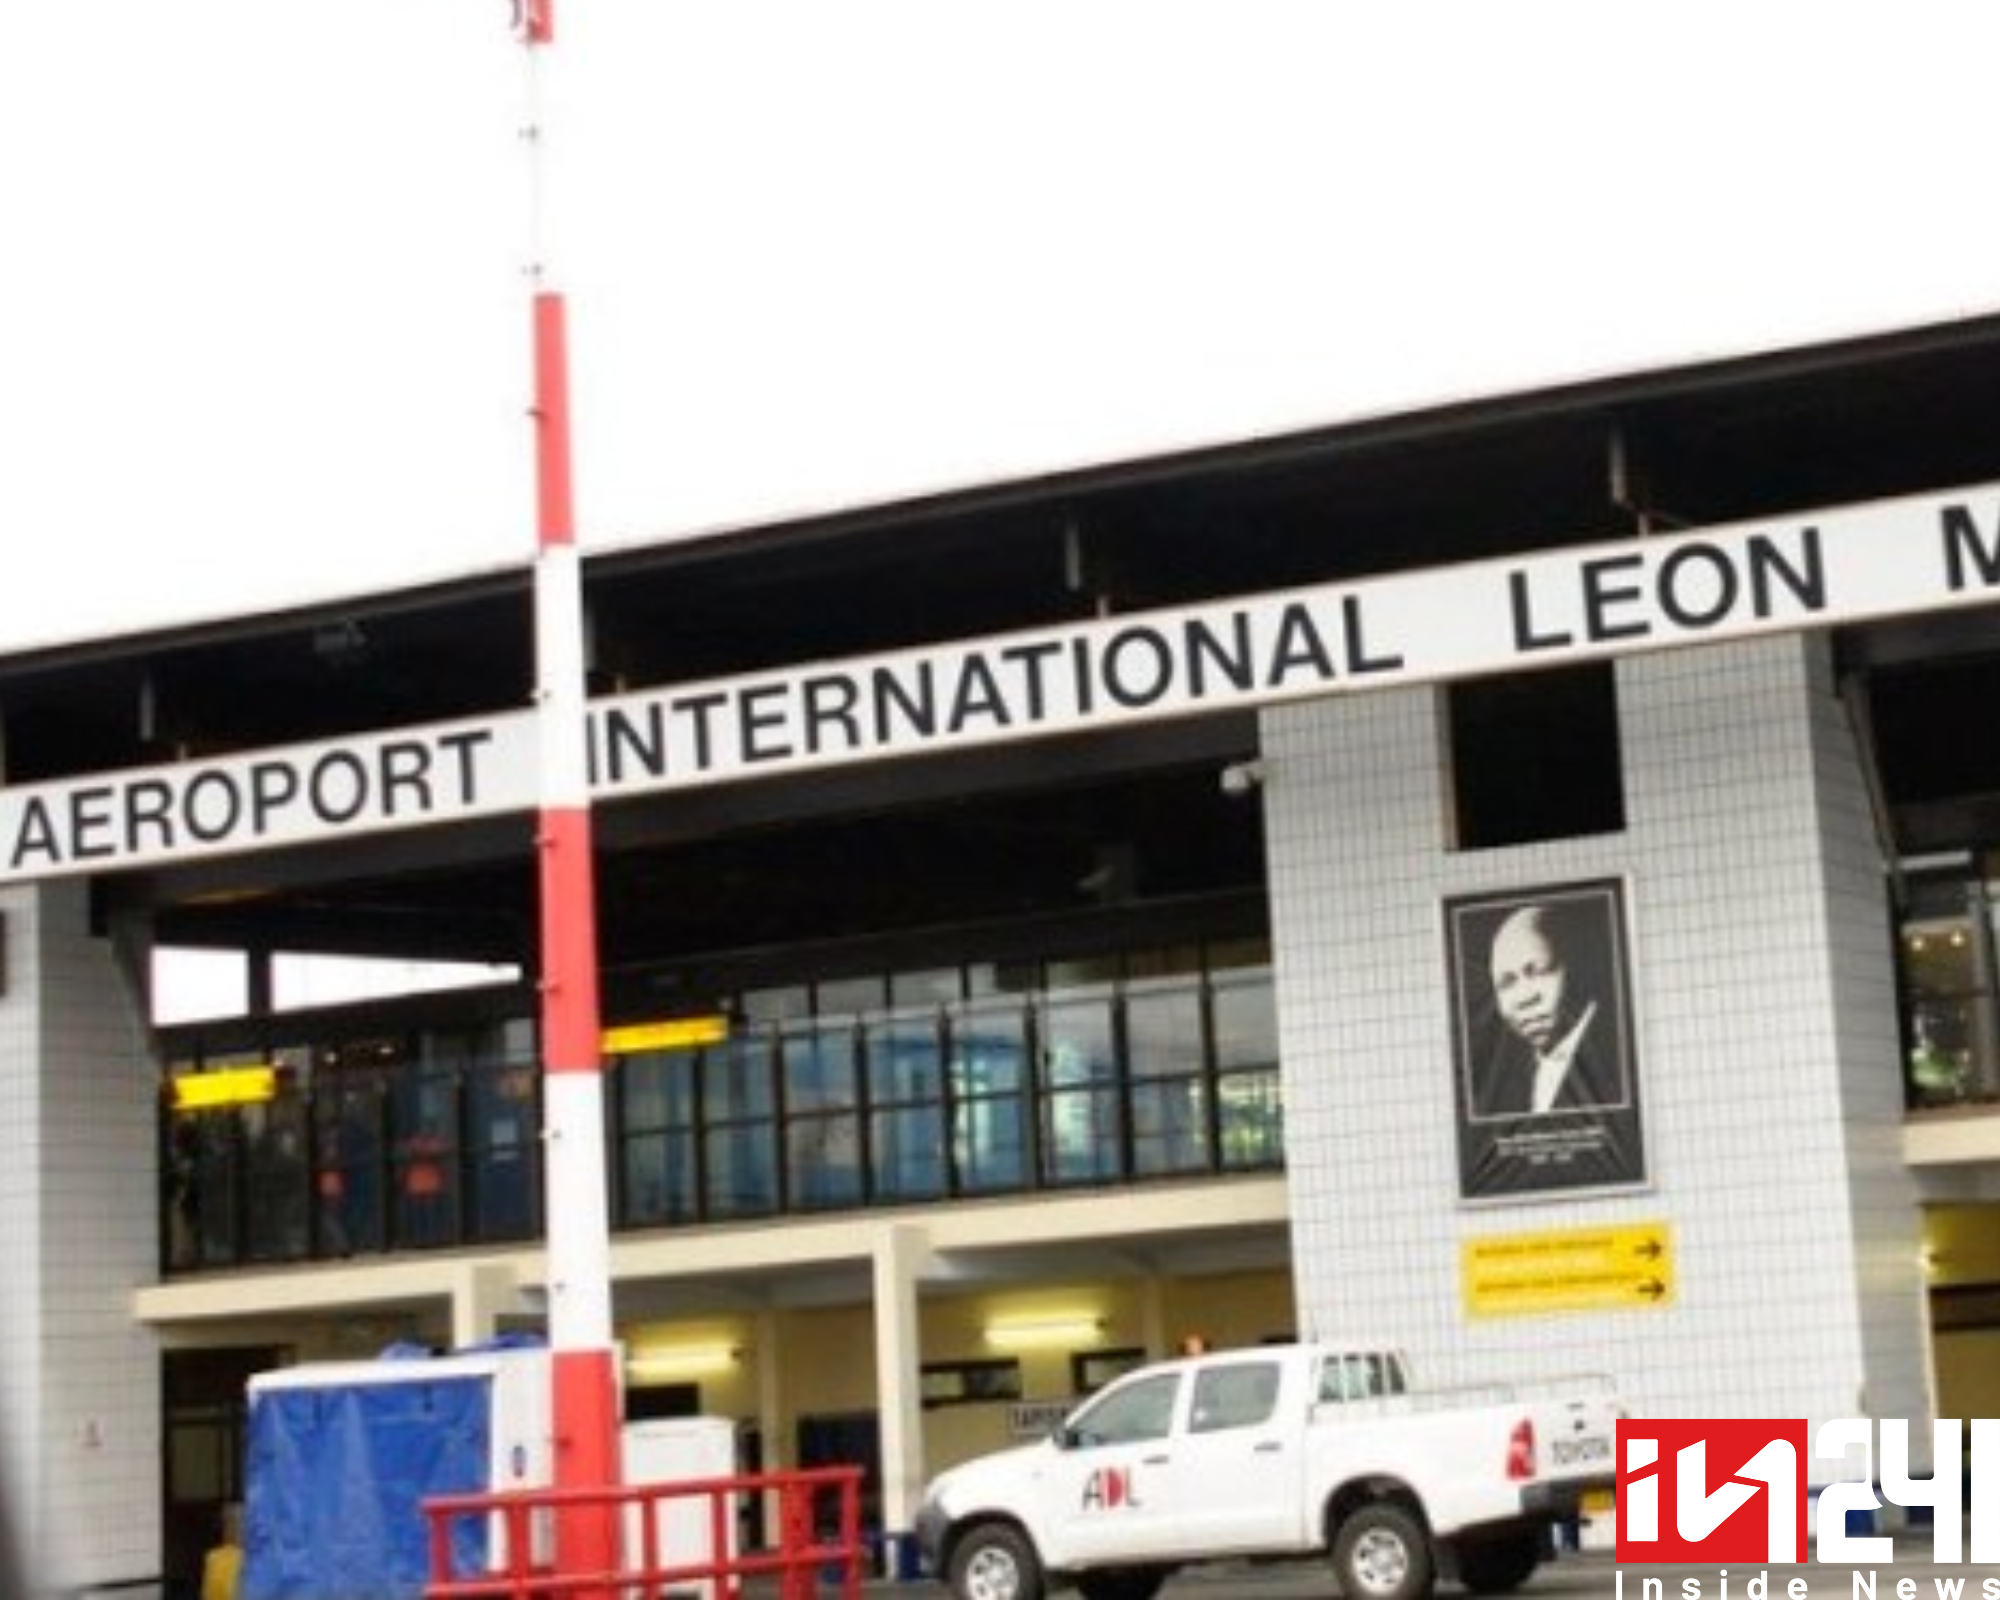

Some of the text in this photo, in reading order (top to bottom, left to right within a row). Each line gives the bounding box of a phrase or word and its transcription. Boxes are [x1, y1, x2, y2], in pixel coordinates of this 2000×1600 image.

[11, 730, 492, 867] AEROPORT
[585, 594, 1402, 784] INTERNATIONAL
[1510, 527, 1826, 652] LEON
[1082, 1466, 1140, 1510] ADL
